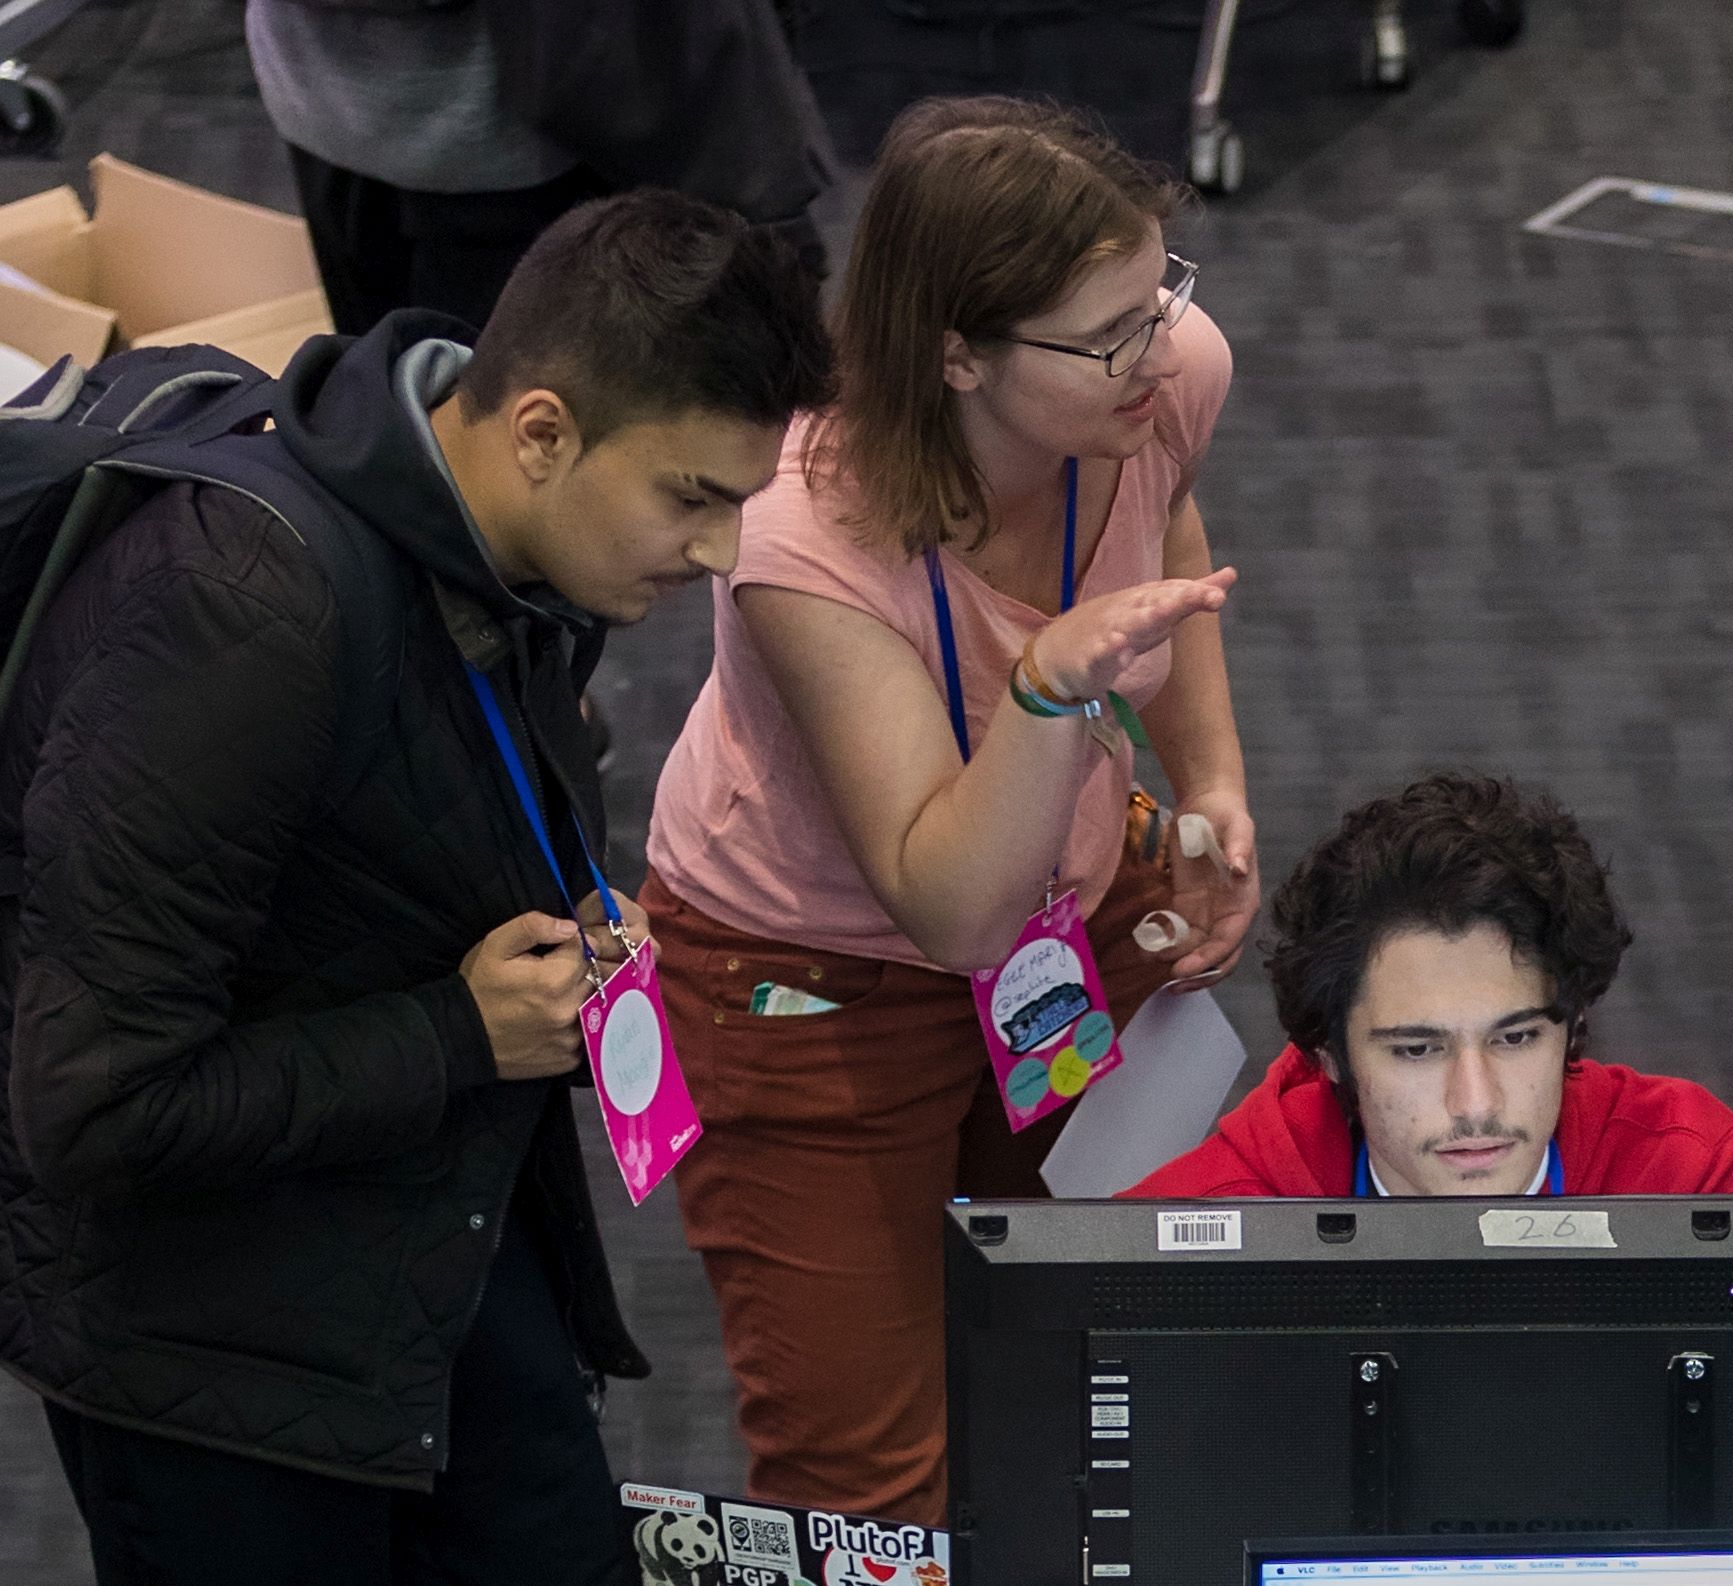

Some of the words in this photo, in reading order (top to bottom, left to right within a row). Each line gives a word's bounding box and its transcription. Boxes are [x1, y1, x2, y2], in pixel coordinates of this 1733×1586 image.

[1163, 1214, 1177, 1222] DO
[1178, 1214, 1195, 1222] NOT
[1198, 1213, 1233, 1222] REMOVE
[627, 1490, 666, 1504] Maker
[669, 1495, 697, 1508] Fear
[811, 1514, 922, 1562] PlutoF
[724, 1564, 776, 1586] PGP
[1297, 1566, 1315, 1574] VLC
[1327, 1565, 1341, 1573] File
[1353, 1565, 1369, 1573] Edit
[1411, 1564, 1448, 1573] Playback
[1576, 1560, 1609, 1568] Window
